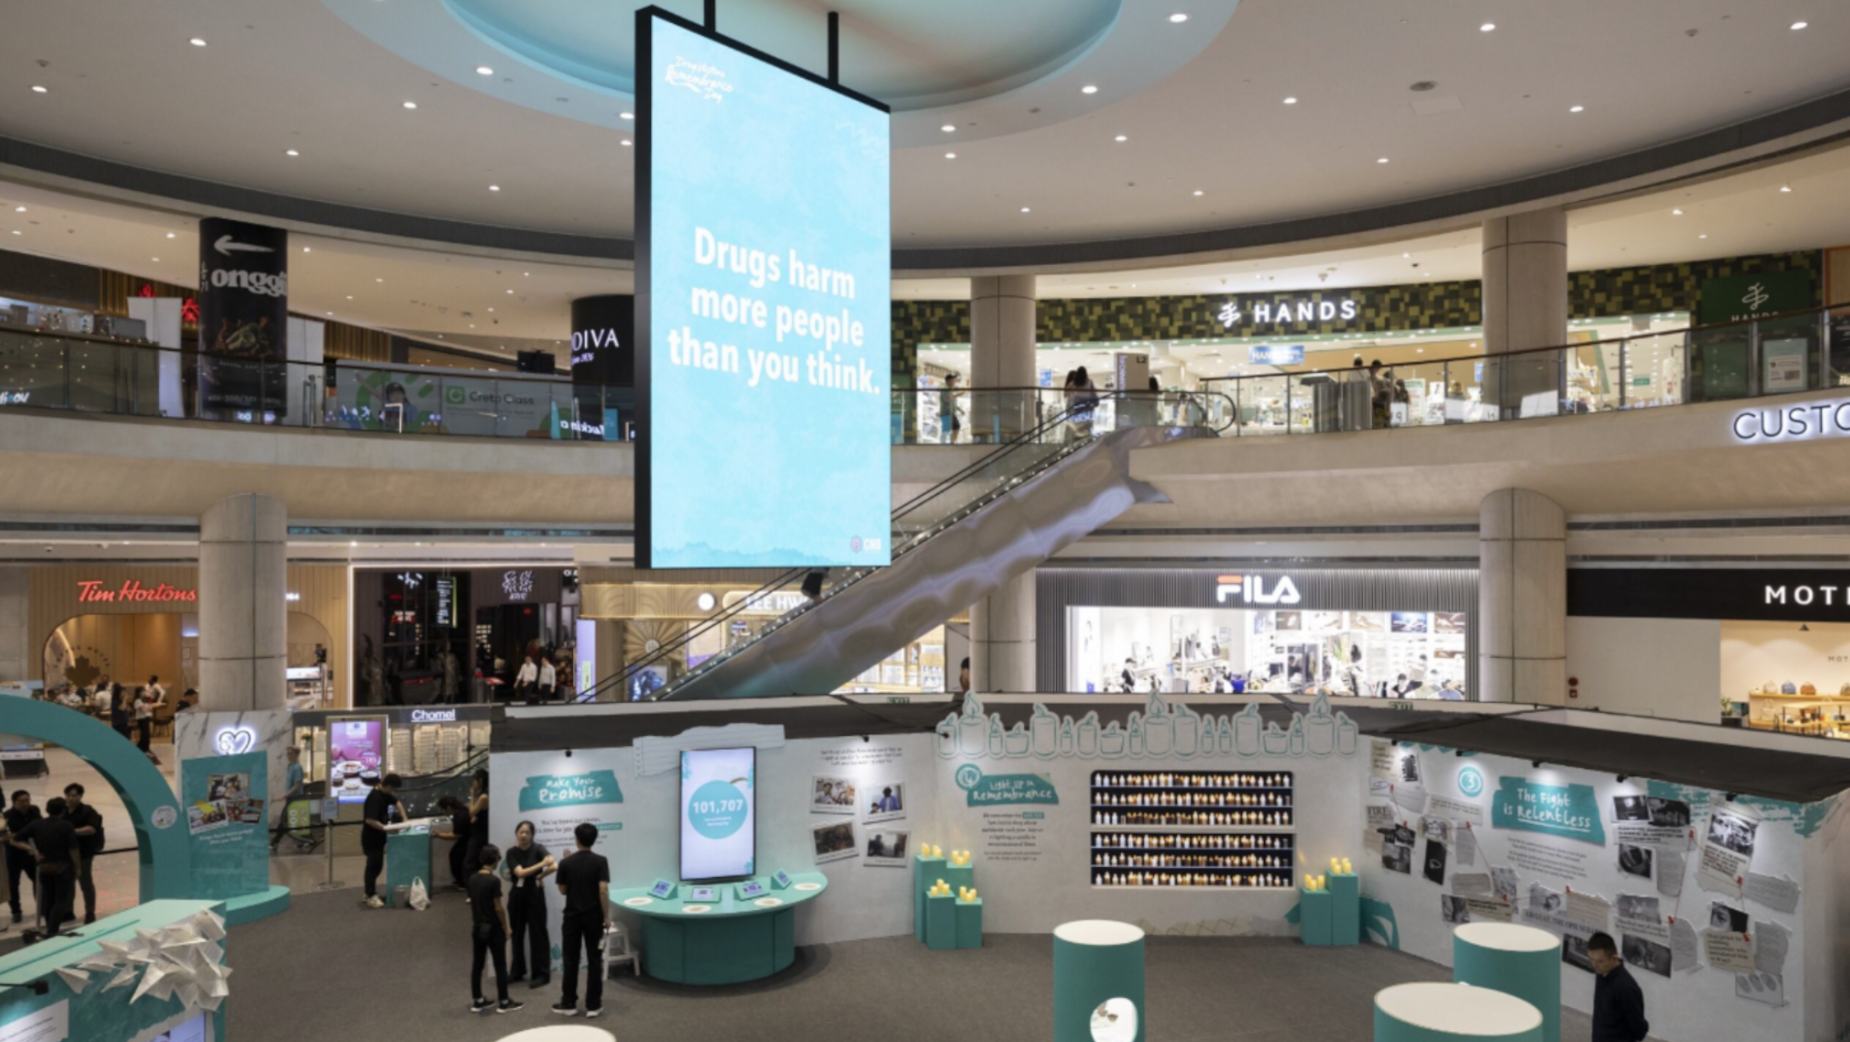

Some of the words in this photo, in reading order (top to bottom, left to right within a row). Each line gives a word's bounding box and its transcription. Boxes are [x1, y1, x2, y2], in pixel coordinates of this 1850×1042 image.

[665, 64, 734, 93] Remembrance
[695, 228, 781, 289] Drugs
[789, 250, 855, 298] harm
[211, 269, 287, 297] onggi
[691, 286, 767, 328] more
[776, 306, 864, 350] people
[1254, 299, 1356, 324] HANDS
[668, 328, 739, 373] than
[748, 353, 799, 388] you
[807, 353, 880, 394] think.
[503, 393, 534, 405] Class
[77, 580, 115, 602] Tim
[118, 580, 198, 602] Hortons
[1216, 576, 1300, 603] FILA
[1765, 585, 1850, 605] MOT
[411, 709, 456, 721] Chomel
[540, 786, 603, 803] Promise
[973, 788, 1052, 800] Remembrance
[1517, 788, 1536, 803] The
[693, 799, 743, 815] 101,707
[1504, 803, 1513, 815] is
[1517, 806, 1591, 828] Relentless
